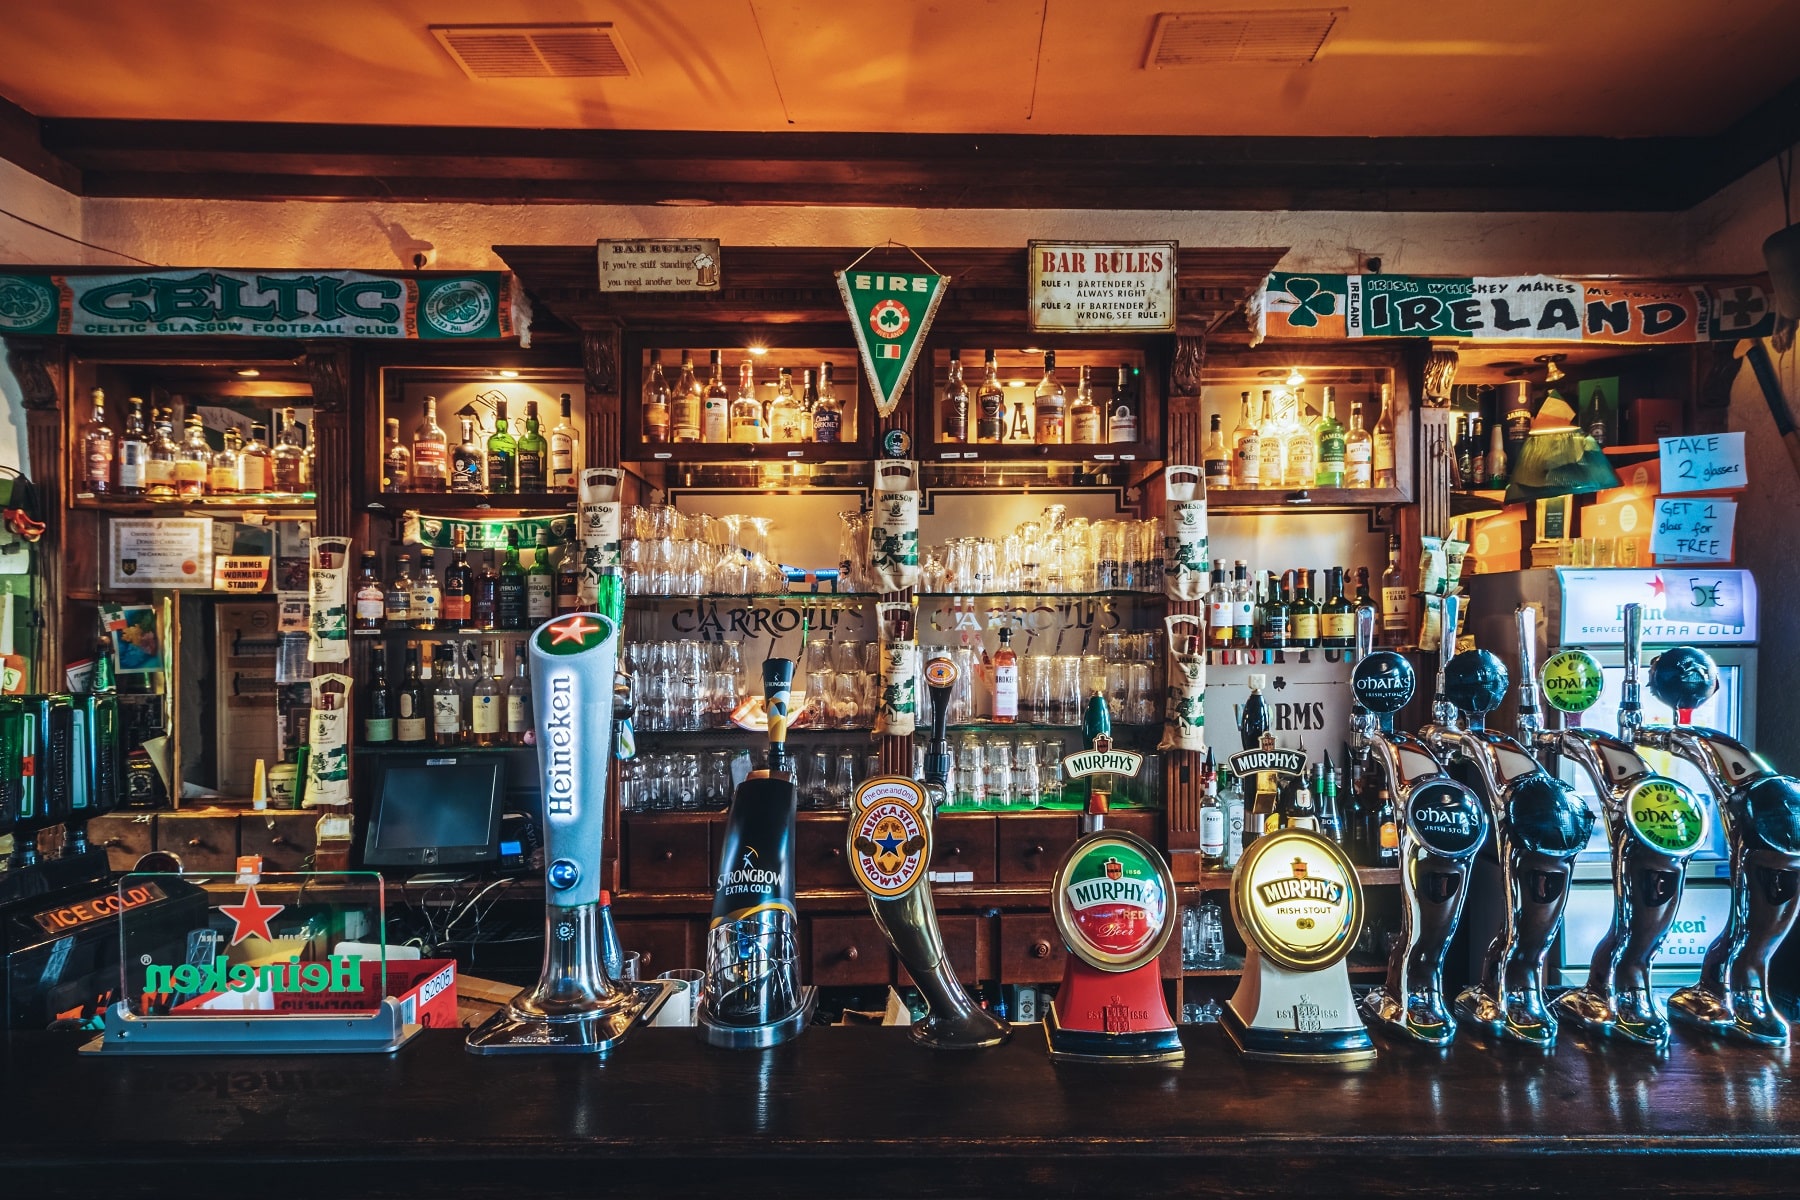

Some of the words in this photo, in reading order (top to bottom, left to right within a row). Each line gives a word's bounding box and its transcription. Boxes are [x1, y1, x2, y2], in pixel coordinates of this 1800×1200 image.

[612, 245, 646, 253] BAR
[650, 245, 702, 253] RULES
[612, 261, 637, 270] you're
[1041, 252, 1086, 273] BAR
[1094, 252, 1163, 273] RULES
[608, 279, 621, 288] you
[624, 278, 642, 286] need
[645, 277, 672, 286] another
[676, 277, 692, 285] beer
[855, 275, 928, 292] EIRE
[1367, 280, 1418, 292] IRISH
[1428, 283, 1508, 294] WHISKEY
[1517, 281, 1577, 294] MAKES
[1587, 288, 1612, 296] ME
[79, 272, 402, 323] CELTIC
[1350, 281, 1360, 328] IRELAND
[1370, 294, 1689, 336] IRELAND
[84, 324, 146, 333] CELTIC
[157, 322, 243, 332] GLASGOW
[252, 324, 345, 334] FOOTBALL
[355, 326, 398, 335] CLUB
[1664, 437, 1719, 454] TAKE
[1679, 460, 1696, 479] 2
[1704, 462, 1739, 481] glasses
[880, 494, 912, 502] JAMESON
[1661, 501, 1693, 515] GET
[1704, 504, 1717, 519] 1
[450, 523, 539, 540] IRELAND
[1659, 522, 1682, 534] glass
[1692, 522, 1712, 537] for
[1677, 539, 1720, 555] FREE
[1689, 577, 1725, 607] 5€
[672, 605, 864, 638] CARROLL'S
[1642, 626, 1689, 635] XTRA
[1697, 625, 1743, 635] COLD
[548, 675, 572, 817] Heineken
[1072, 755, 1133, 772] MURPHY'S
[1237, 753, 1299, 772] MURPHY'S
[864, 792, 875, 802] The
[876, 788, 889, 796] One
[902, 790, 915, 801] Only
[862, 806, 918, 836] NEWCASTLE
[862, 857, 902, 886] BROWN
[902, 857, 917, 879] ALE
[717, 869, 785, 892] STRONGBOW
[726, 884, 748, 895] EXTRA
[750, 884, 772, 894] COLD
[1075, 882, 1146, 905] MURPHY
[1263, 880, 1339, 903] MURPHY'S
[50, 905, 93, 927] ICE
[92, 887, 154, 915] COLD!
[1123, 911, 1144, 920] RED
[1097, 924, 1134, 938] Beer
[1669, 946, 1706, 955] COLD
[424, 969, 450, 1001] 82605
